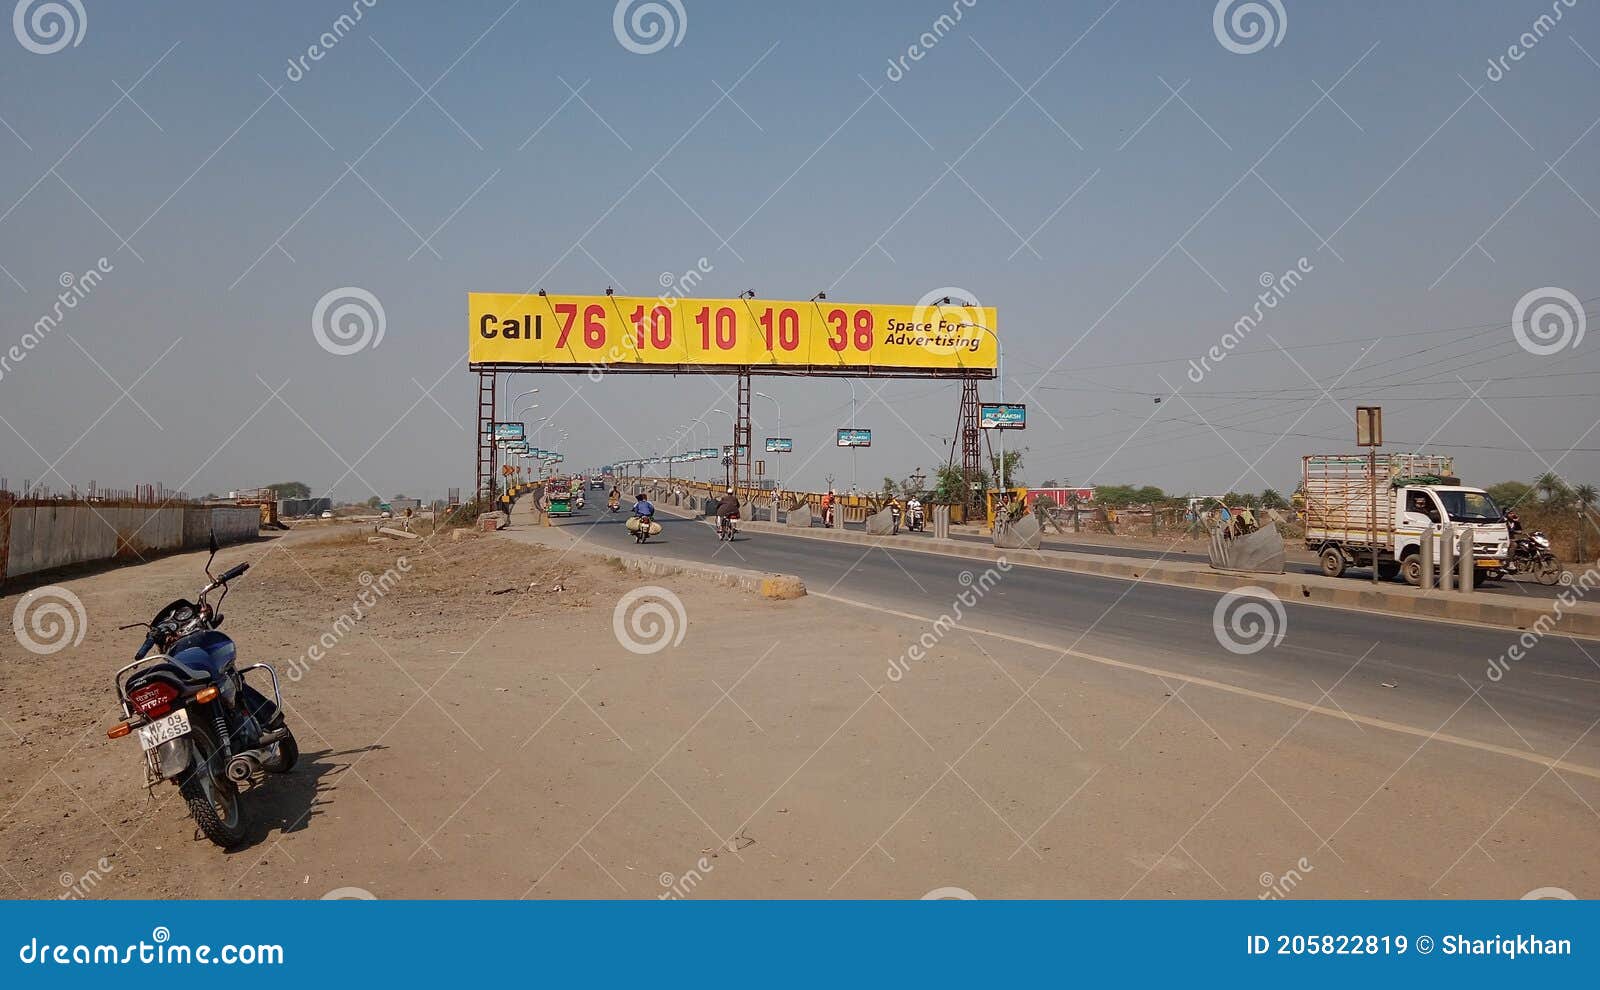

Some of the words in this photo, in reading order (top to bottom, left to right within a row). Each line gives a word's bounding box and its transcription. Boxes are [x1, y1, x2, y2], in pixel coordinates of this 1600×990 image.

[480, 314, 542, 339] Call
[555, 303, 606, 350] 76
[630, 305, 672, 350] 10
[695, 306, 737, 351] 10
[760, 307, 799, 352] 10
[828, 309, 874, 352] 38
[887, 318, 932, 334] Space
[938, 320, 963, 333] For
[884, 334, 980, 352] Advertising
[149, 722, 162, 736] MP
